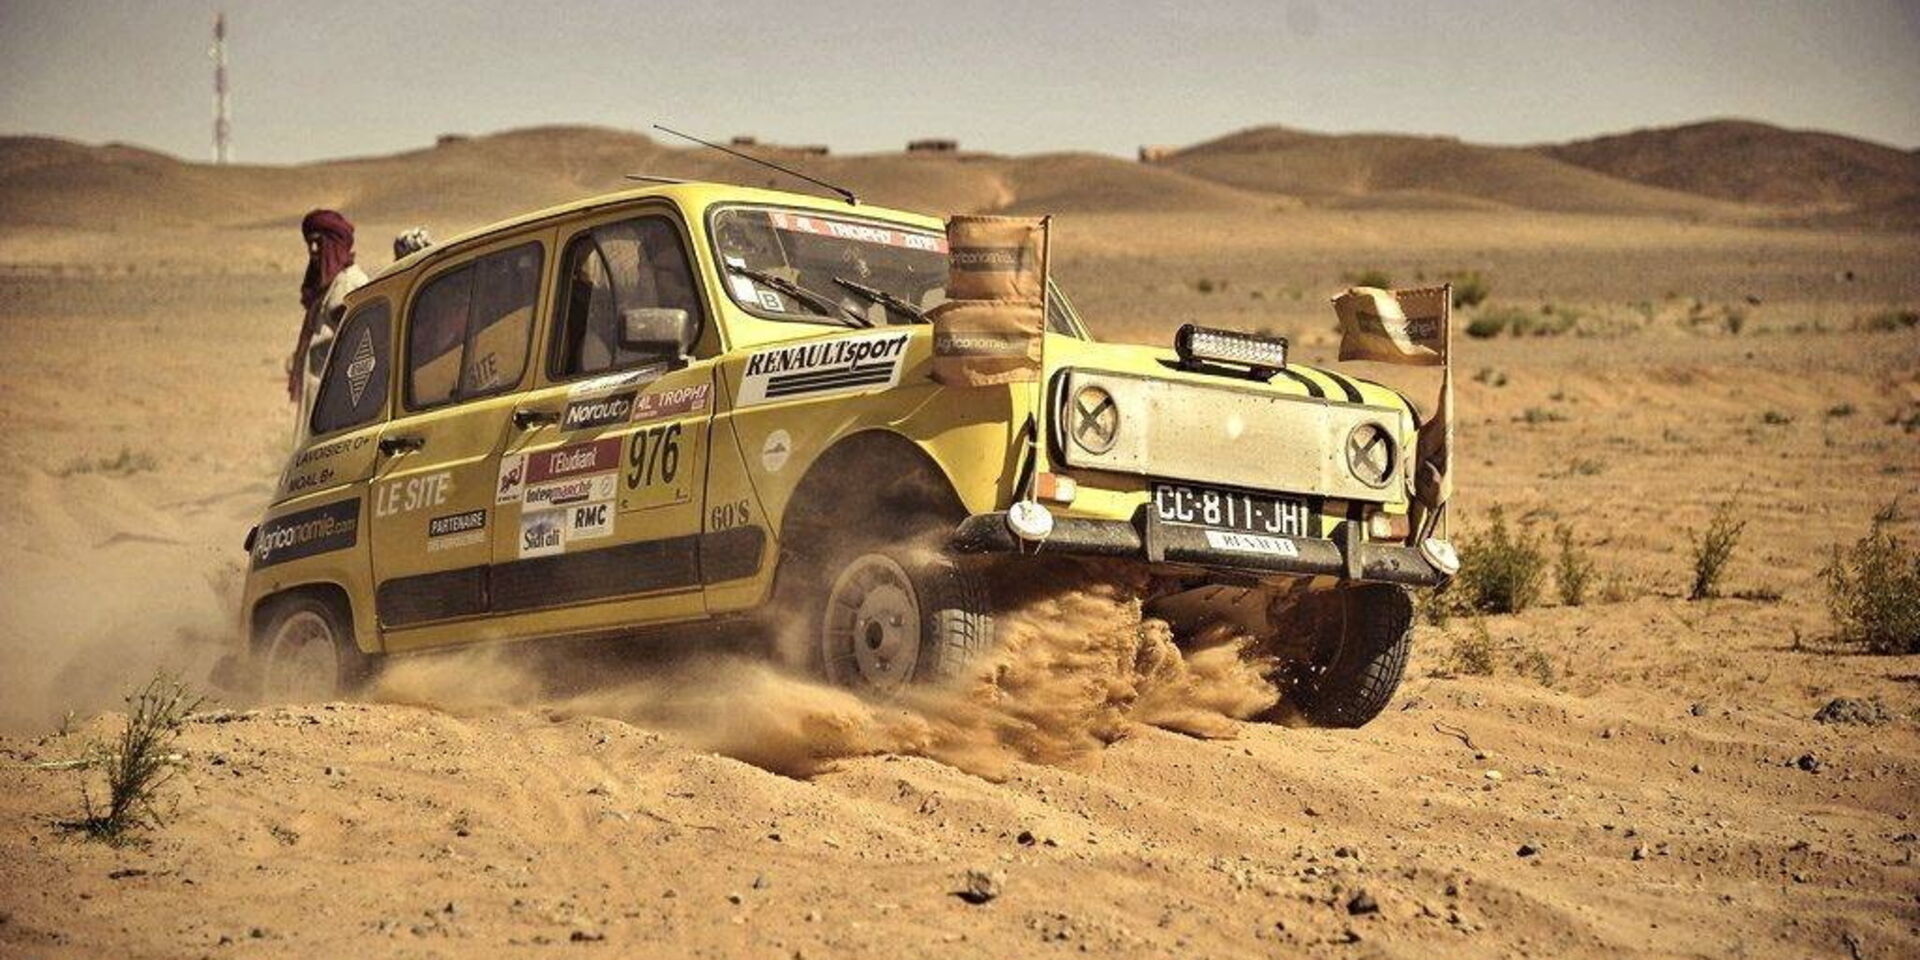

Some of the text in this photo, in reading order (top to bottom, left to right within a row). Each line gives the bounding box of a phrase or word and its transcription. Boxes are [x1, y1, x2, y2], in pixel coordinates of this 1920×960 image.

[763, 293, 780, 308] B
[658, 384, 710, 407] TROPHY
[627, 423, 681, 490] 976
[376, 472, 452, 518] LE SITE
[575, 504, 607, 529] RMC
